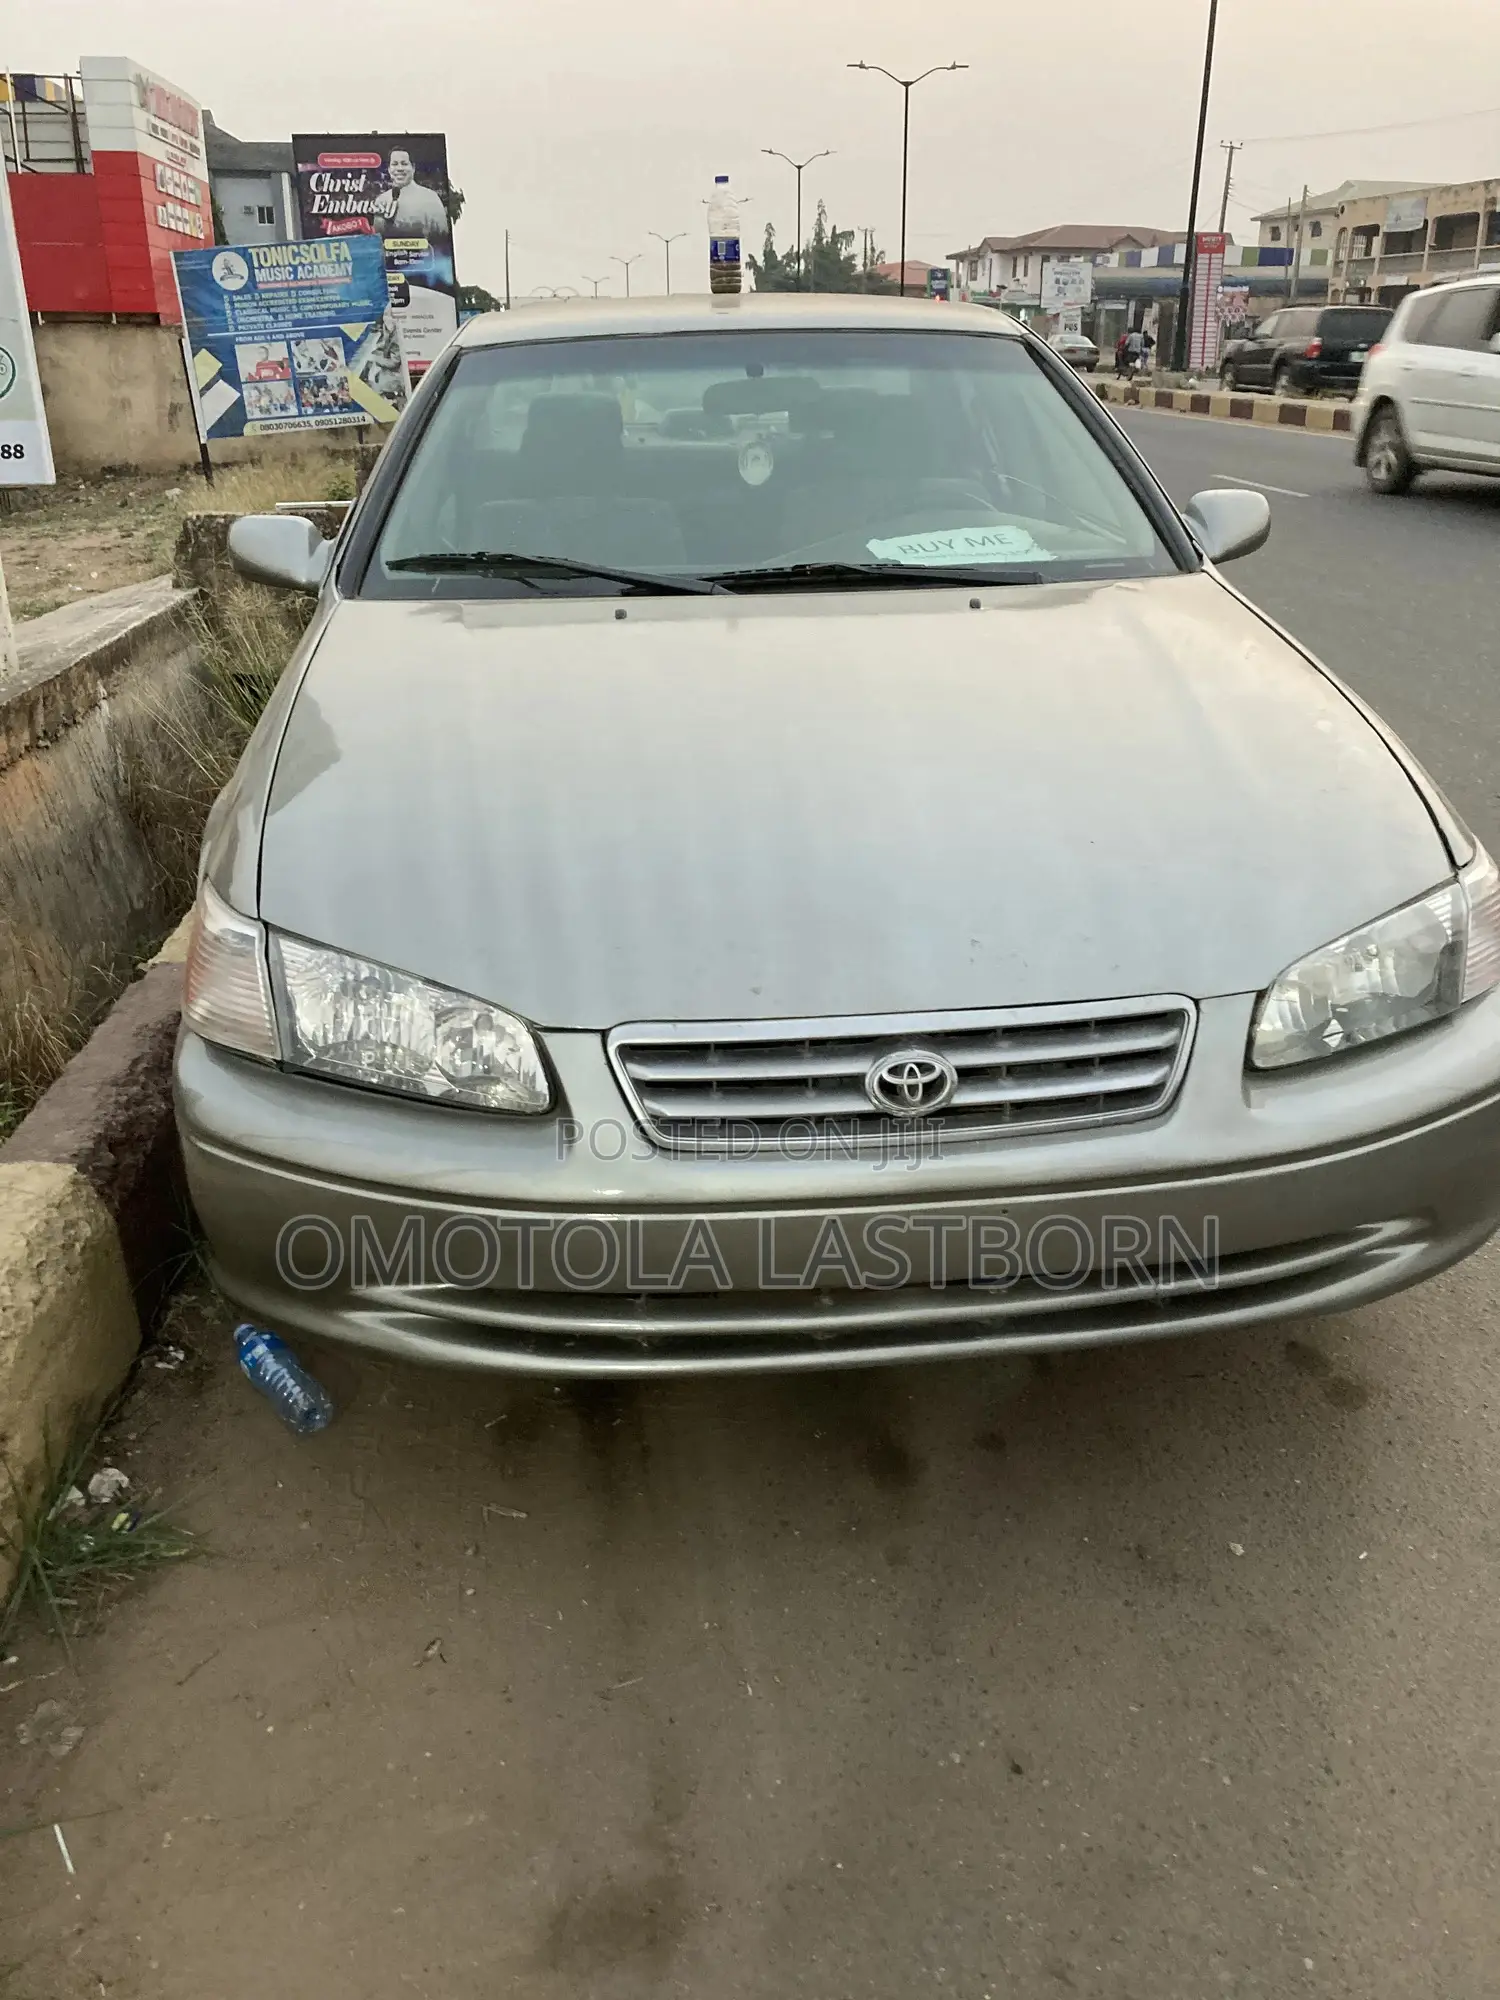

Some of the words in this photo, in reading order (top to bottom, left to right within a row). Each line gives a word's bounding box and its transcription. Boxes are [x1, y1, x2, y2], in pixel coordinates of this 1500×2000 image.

[310, 172, 366, 192] Christ
[312, 193, 398, 218] Embassy
[248, 241, 352, 267] TONICSOLFA
[386, 250, 408, 258] English
[254, 266, 294, 282] MUSIC
[297, 262, 353, 279] ACADEMY
[898, 538, 955, 554] BUY
[964, 533, 1013, 548] ME
